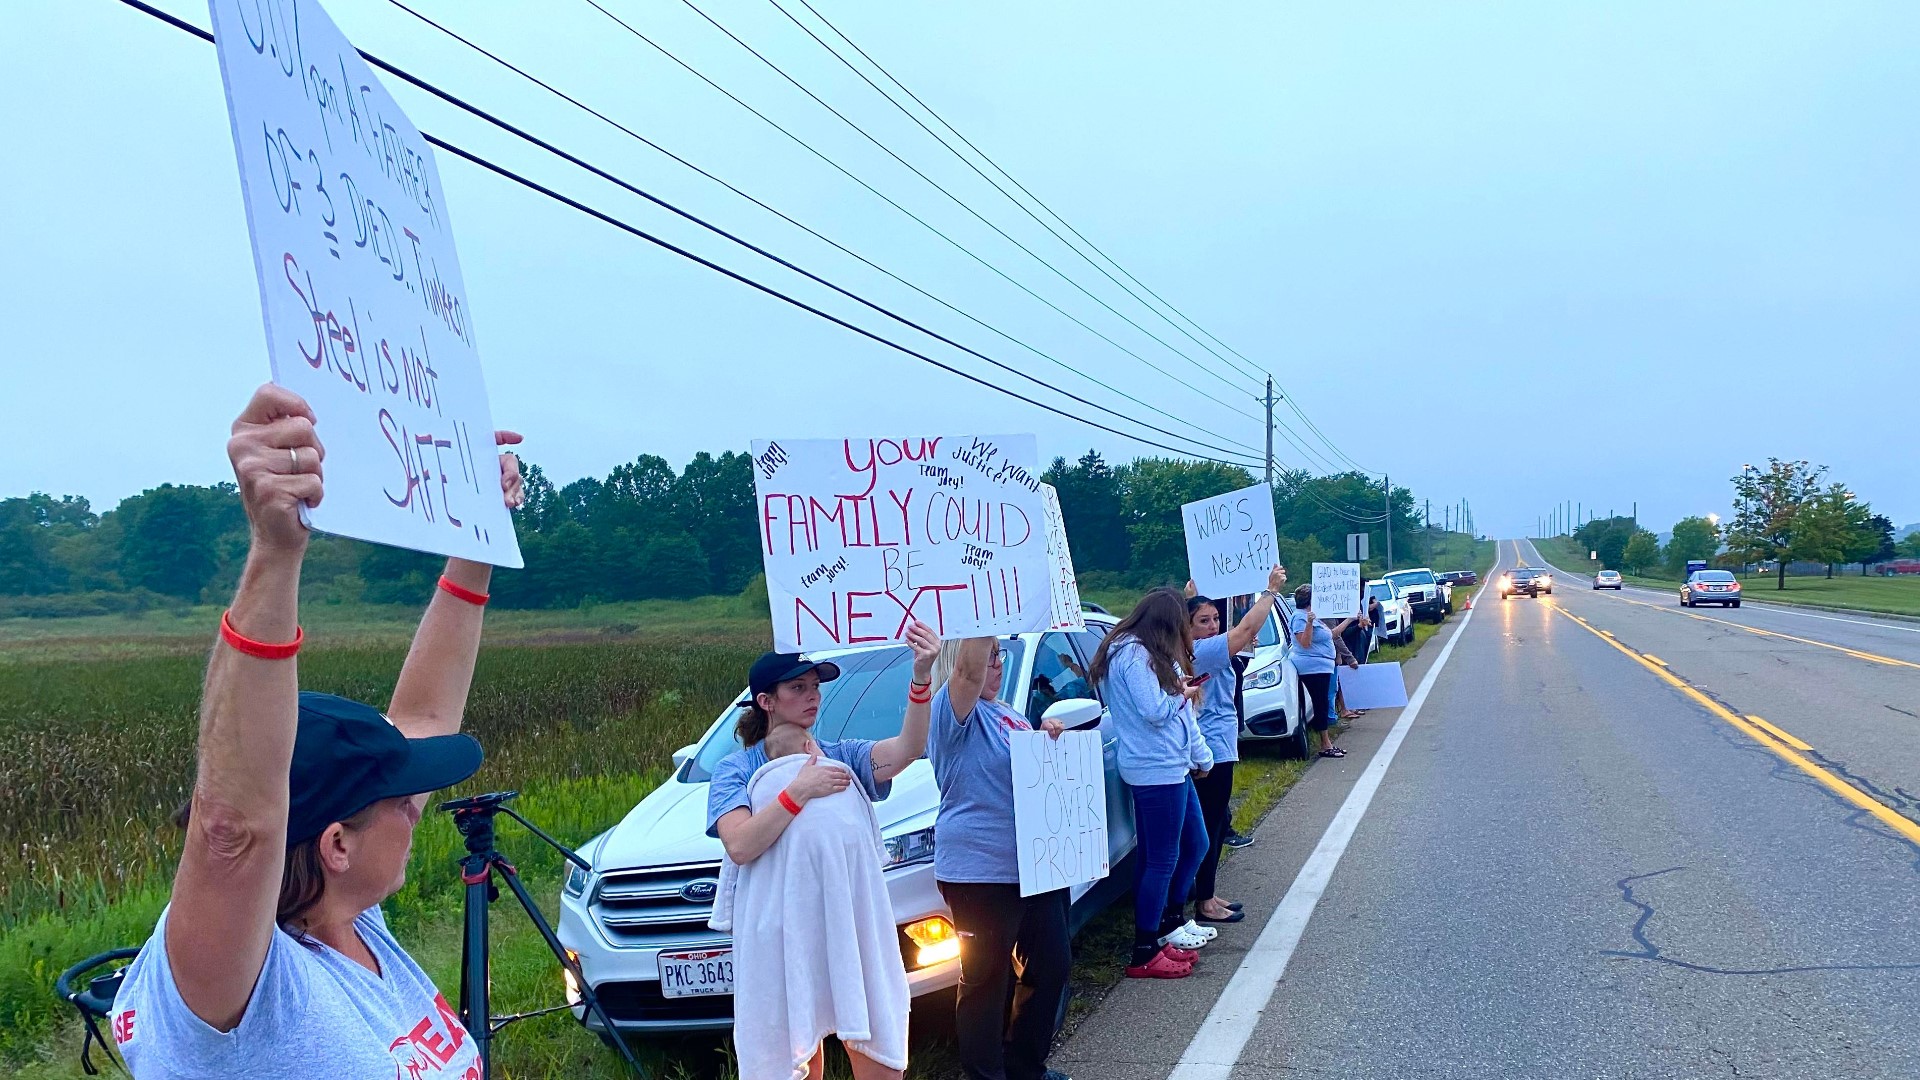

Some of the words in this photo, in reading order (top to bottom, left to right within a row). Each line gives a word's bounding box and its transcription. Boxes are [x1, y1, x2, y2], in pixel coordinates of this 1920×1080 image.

[262, 120, 302, 217] OF
[308, 148, 336, 228] 3
[282, 252, 371, 395] Steel
[971, 436, 998, 461] We
[764, 488, 912, 555] FAMILY
[926, 491, 1031, 547] COULD
[1193, 498, 1253, 541] WHO'S
[883, 548, 924, 591] BE
[1044, 782, 1101, 835] OVER
[665, 964, 694, 987] PKC
[697, 961, 733, 985] 3643
[688, 952, 708, 961] OHIO
[691, 987, 715, 995] TRUCK
